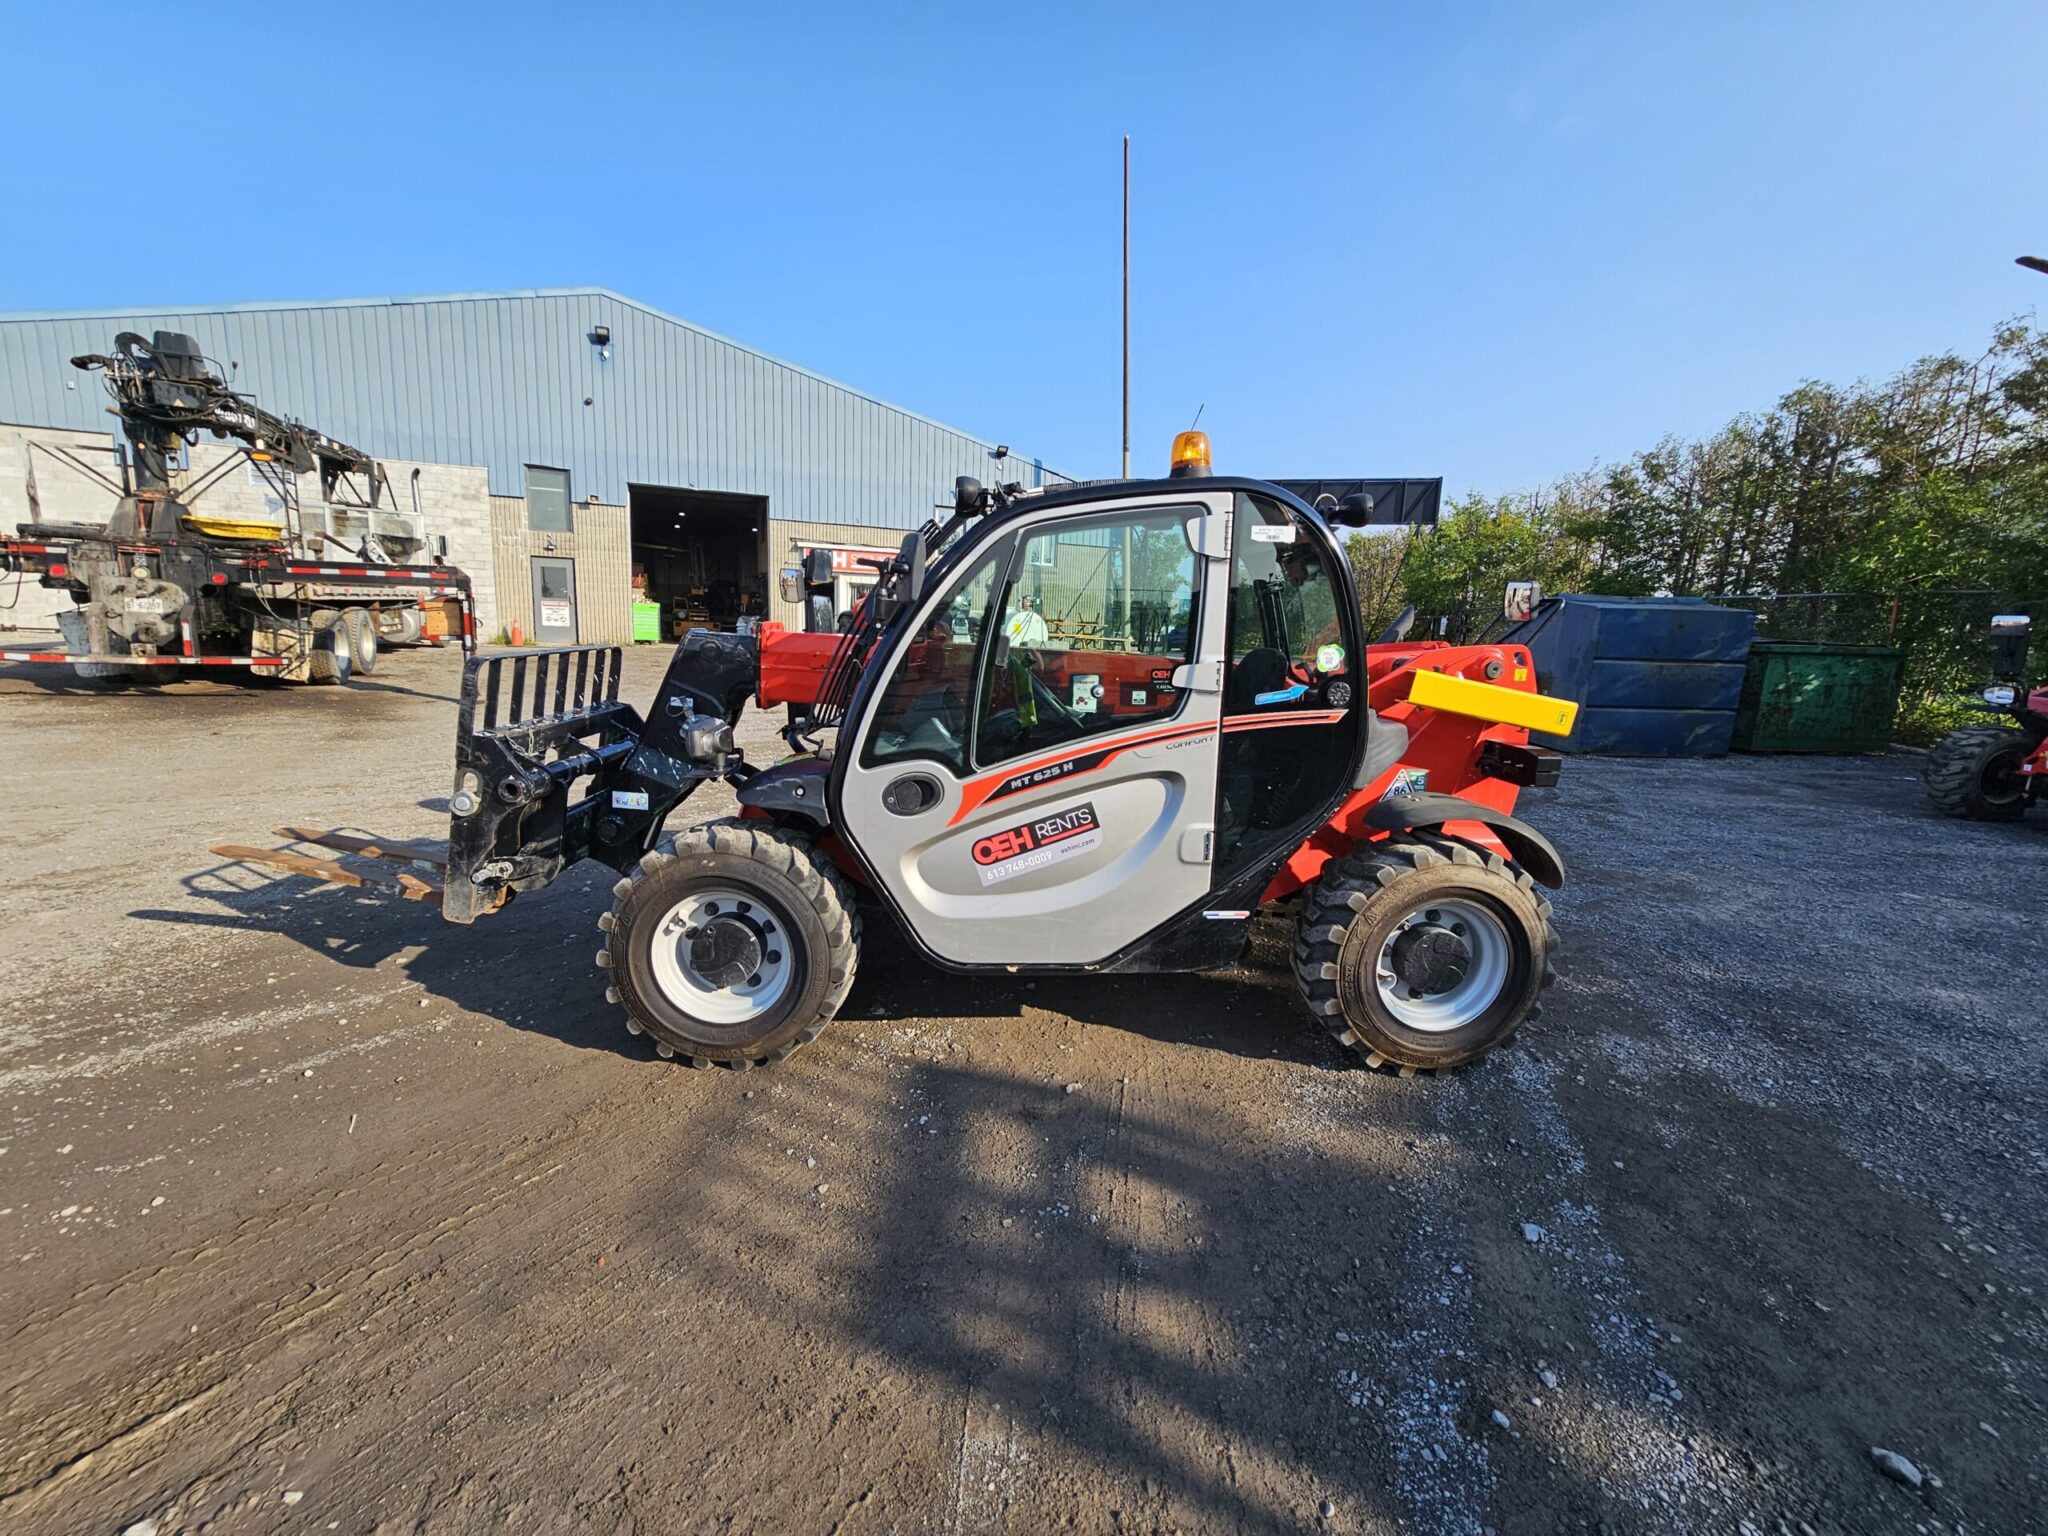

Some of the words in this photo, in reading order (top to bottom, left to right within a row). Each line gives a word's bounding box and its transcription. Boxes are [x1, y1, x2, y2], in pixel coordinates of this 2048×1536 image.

[1152, 670, 1170, 679] OEH
[1165, 734, 1215, 750] COMFORT
[1011, 776, 1031, 789] MT
[1033, 766, 1061, 781] 625
[1063, 761, 1073, 772] H
[973, 827, 1034, 865] OEH
[1035, 808, 1092, 839] RENTS
[1060, 838, 1095, 854] oehinc.com
[987, 867, 1006, 880] 613
[1007, 851, 1052, 873] 748-0009
